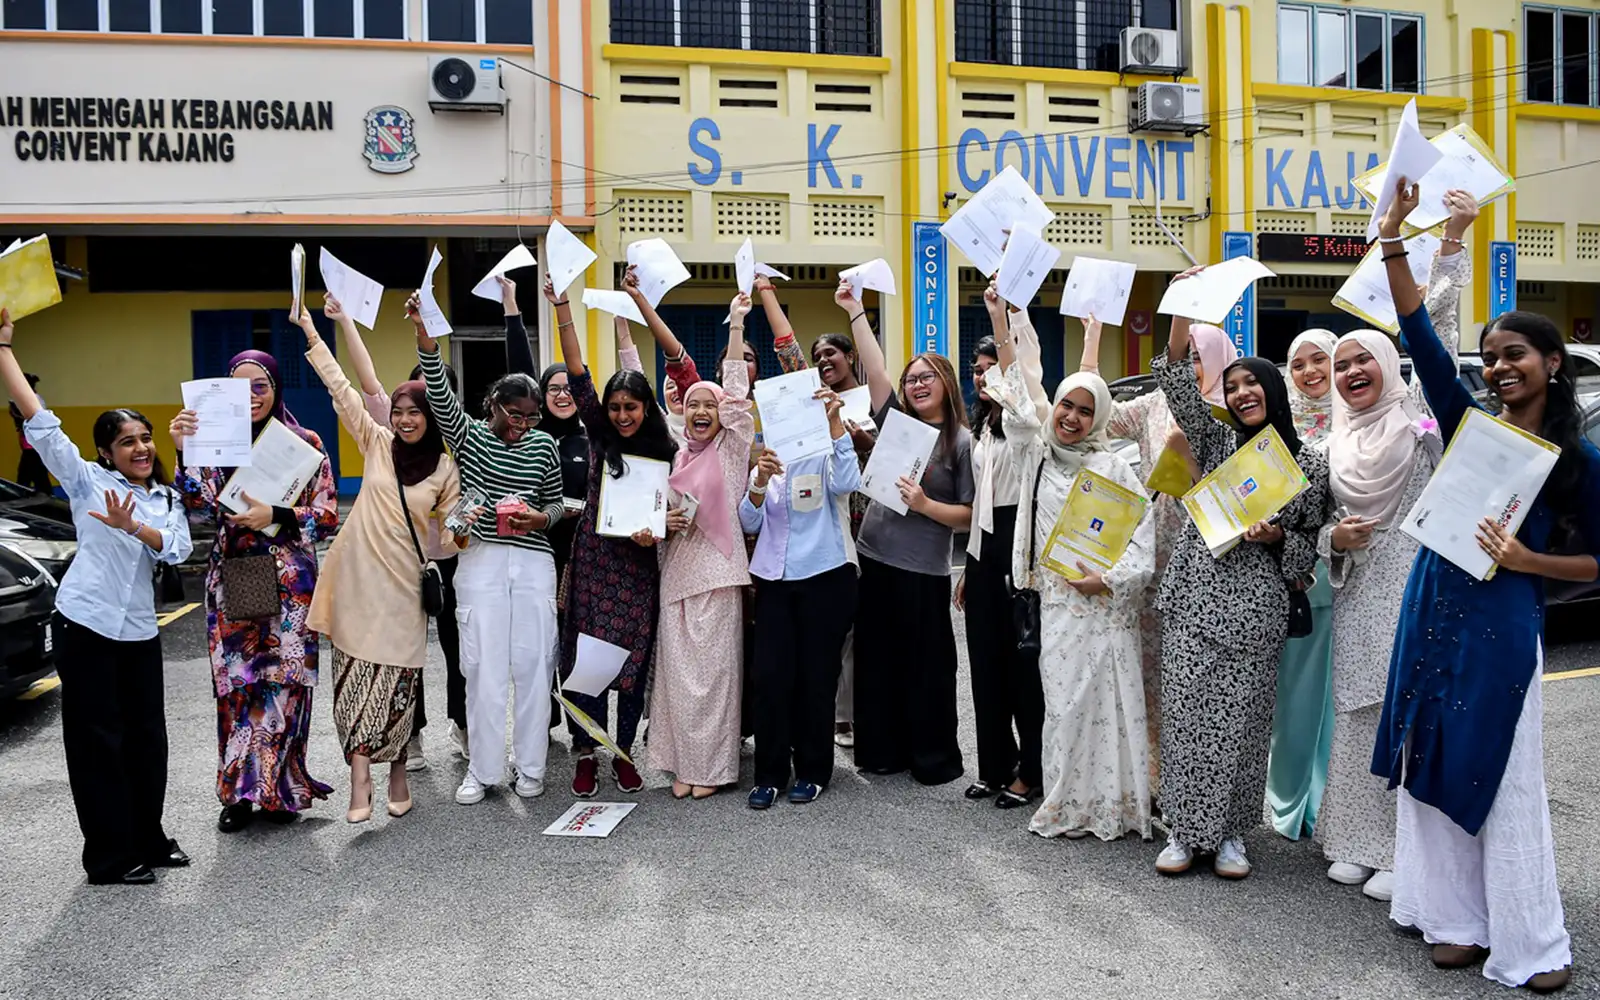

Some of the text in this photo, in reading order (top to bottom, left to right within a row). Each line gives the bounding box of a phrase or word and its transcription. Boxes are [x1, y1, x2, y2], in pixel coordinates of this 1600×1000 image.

[30, 96, 165, 129] MENENGAH
[171, 99, 333, 130] KEBANGSAAN
[14, 130, 234, 163] CONVENT KAJANG
[687, 117, 743, 186] S.
[807, 123, 863, 188] K.
[956, 127, 1194, 200] CONVENT
[924, 245, 938, 352] CONFIDE
[1499, 252, 1508, 305] SELF
